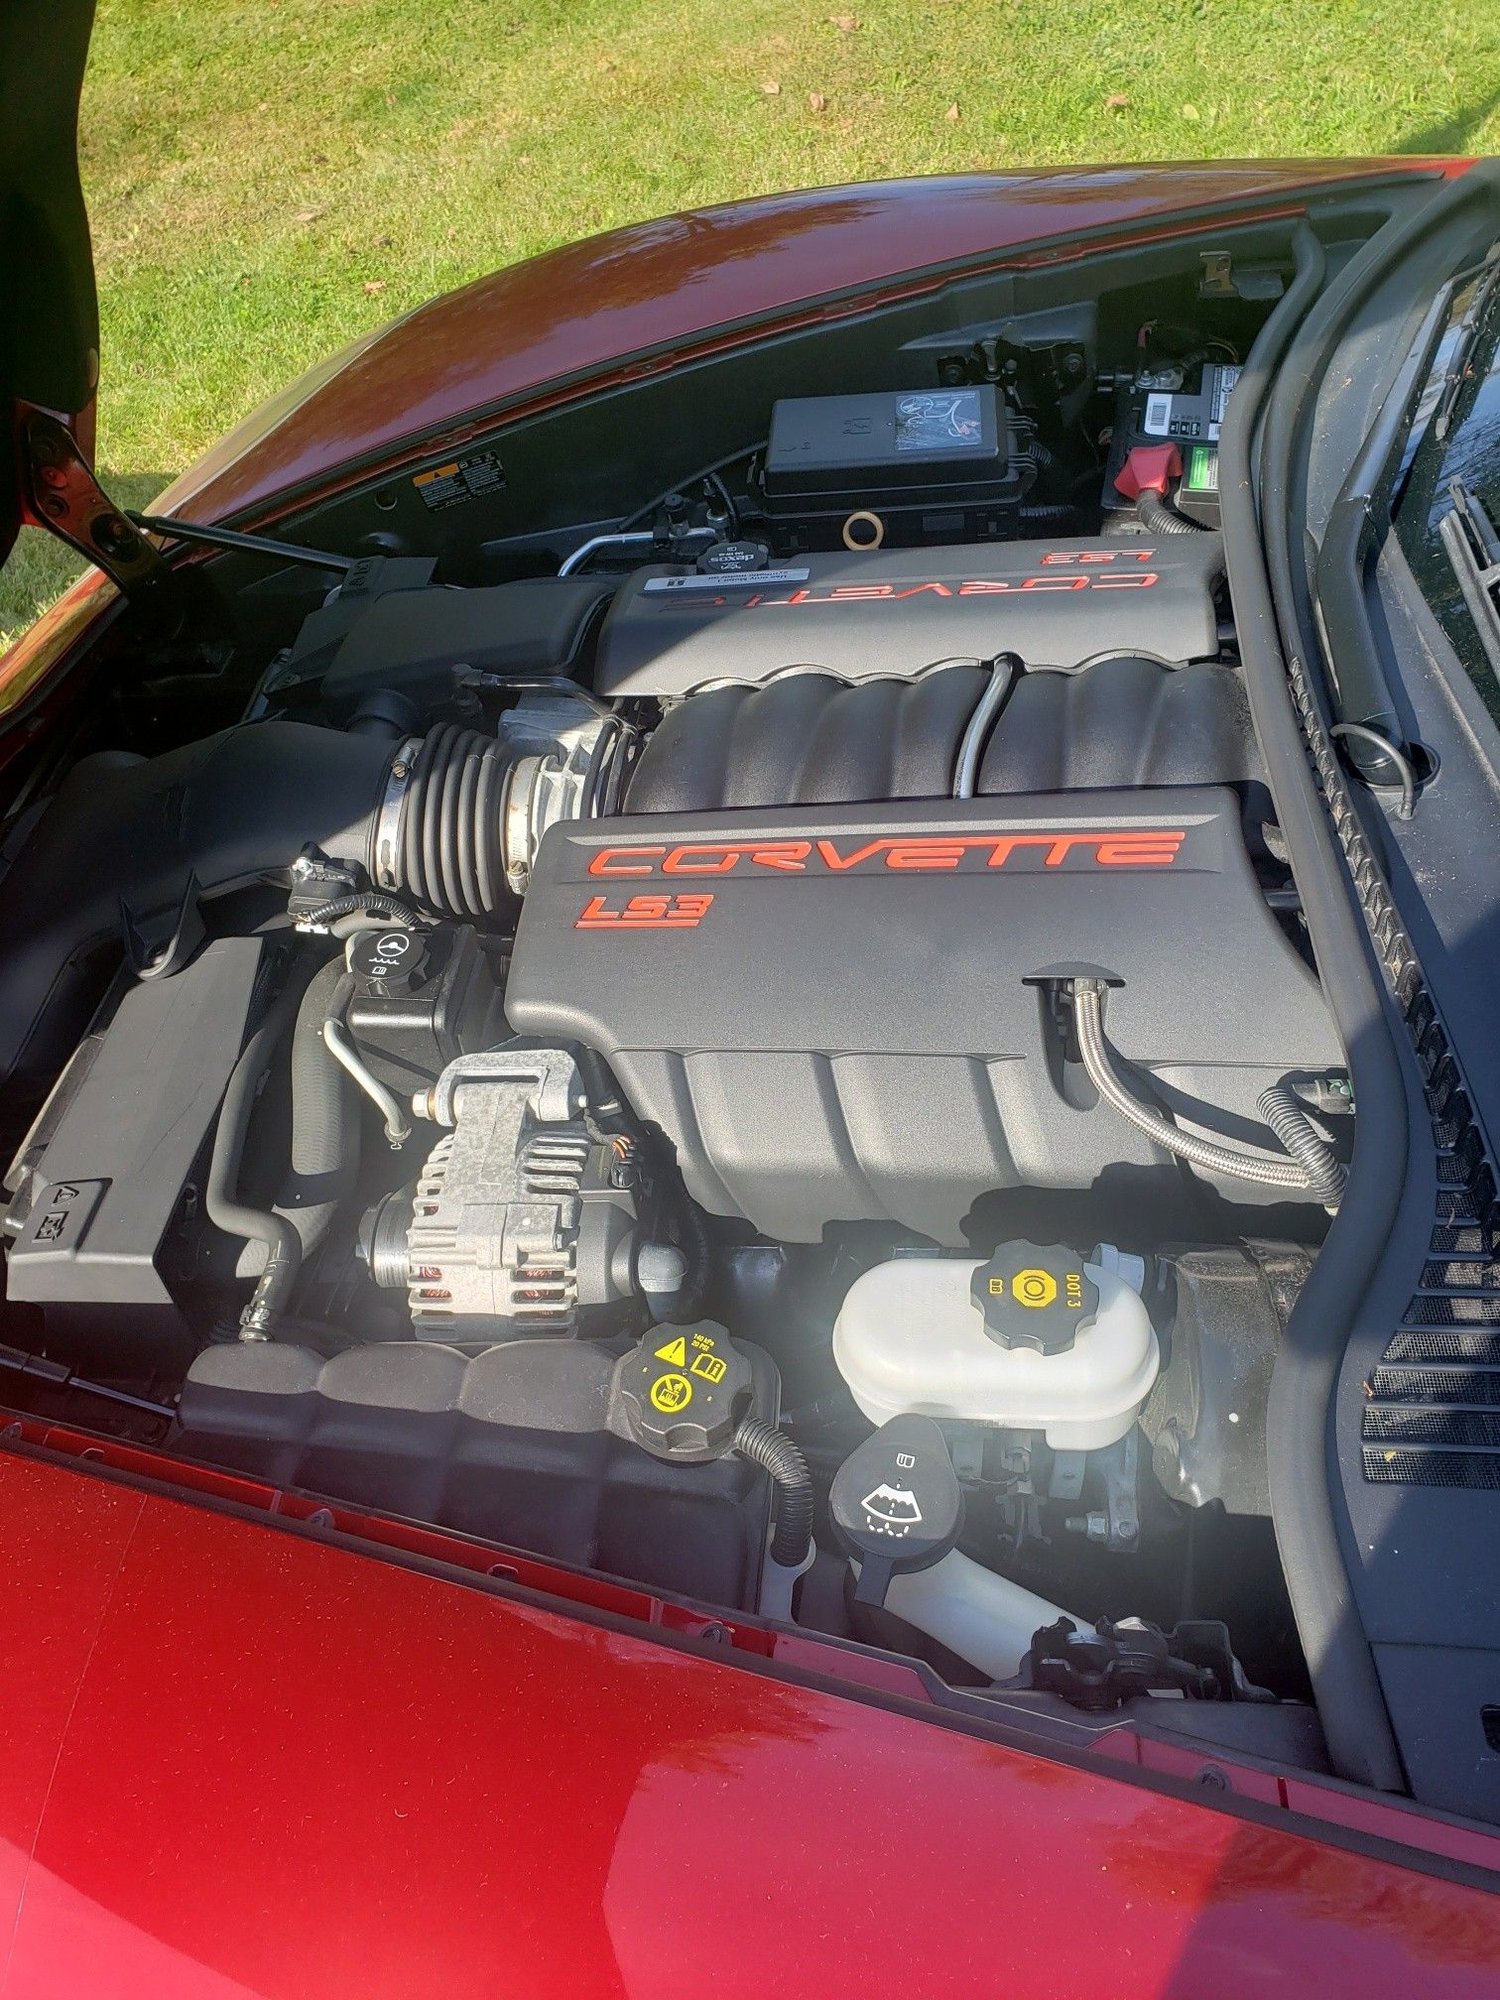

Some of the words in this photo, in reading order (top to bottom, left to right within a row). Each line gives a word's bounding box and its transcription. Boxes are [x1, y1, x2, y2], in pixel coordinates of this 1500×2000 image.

[710, 554, 754, 562] dexos
[1040, 549, 1155, 565] LS3
[659, 572, 1158, 612] CORVETTE
[589, 831, 1185, 875] CORVETTE
[576, 894, 714, 926] LS3
[1066, 1274, 1081, 1297] DOT
[693, 1333, 704, 1342] 140
